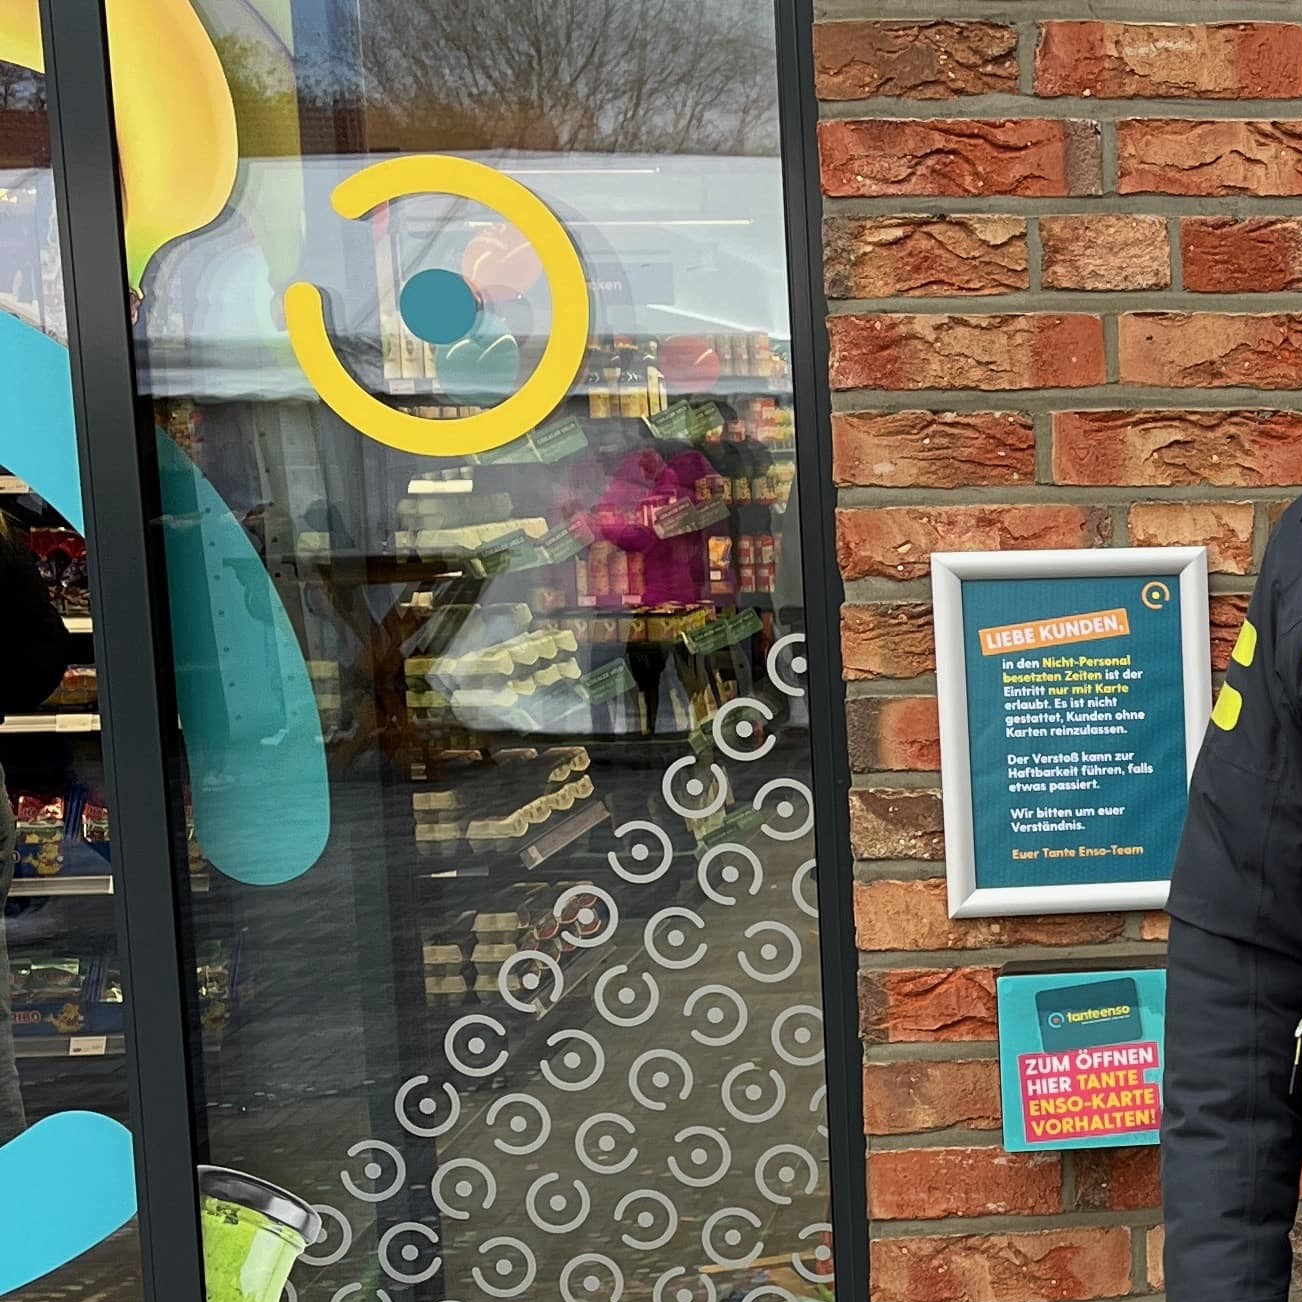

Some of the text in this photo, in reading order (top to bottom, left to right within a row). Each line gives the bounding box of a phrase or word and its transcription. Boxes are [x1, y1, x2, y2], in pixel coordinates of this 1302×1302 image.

[986, 614, 1124, 649] LIEBE KUNDEN,
[1002, 655, 1131, 669] in den Nicht-Personal
[1003, 668, 1143, 683] besetzten Zeiten ist der
[1004, 683, 1129, 697] Eintritt nur mit Karte
[1004, 696, 1117, 710] erlaubt. Es ist nicht
[1005, 709, 1145, 726] gestattet, Kunden ohne
[1006, 724, 1128, 738] Karten reinzulassen.
[1007, 751, 1135, 765] Der Verstoß kann zur
[1007, 763, 1154, 778] Haftbarkeit führen, falls
[1008, 779, 1100, 793] etwas passiert.
[1010, 806, 1125, 819] Wir bitten um euer
[1011, 819, 1085, 833] Verständnis.
[1012, 844, 1144, 860] Euer Tante Enso-Team
[1066, 1005, 1131, 1024] tanteenso
[1025, 1047, 1153, 1076] ZUM ÖFFNEN
[1026, 1069, 1139, 1097] HIER TANTE
[1028, 1088, 1155, 1117] ENSO-KARTE
[1030, 1108, 1157, 1137] VORHALTEN!
